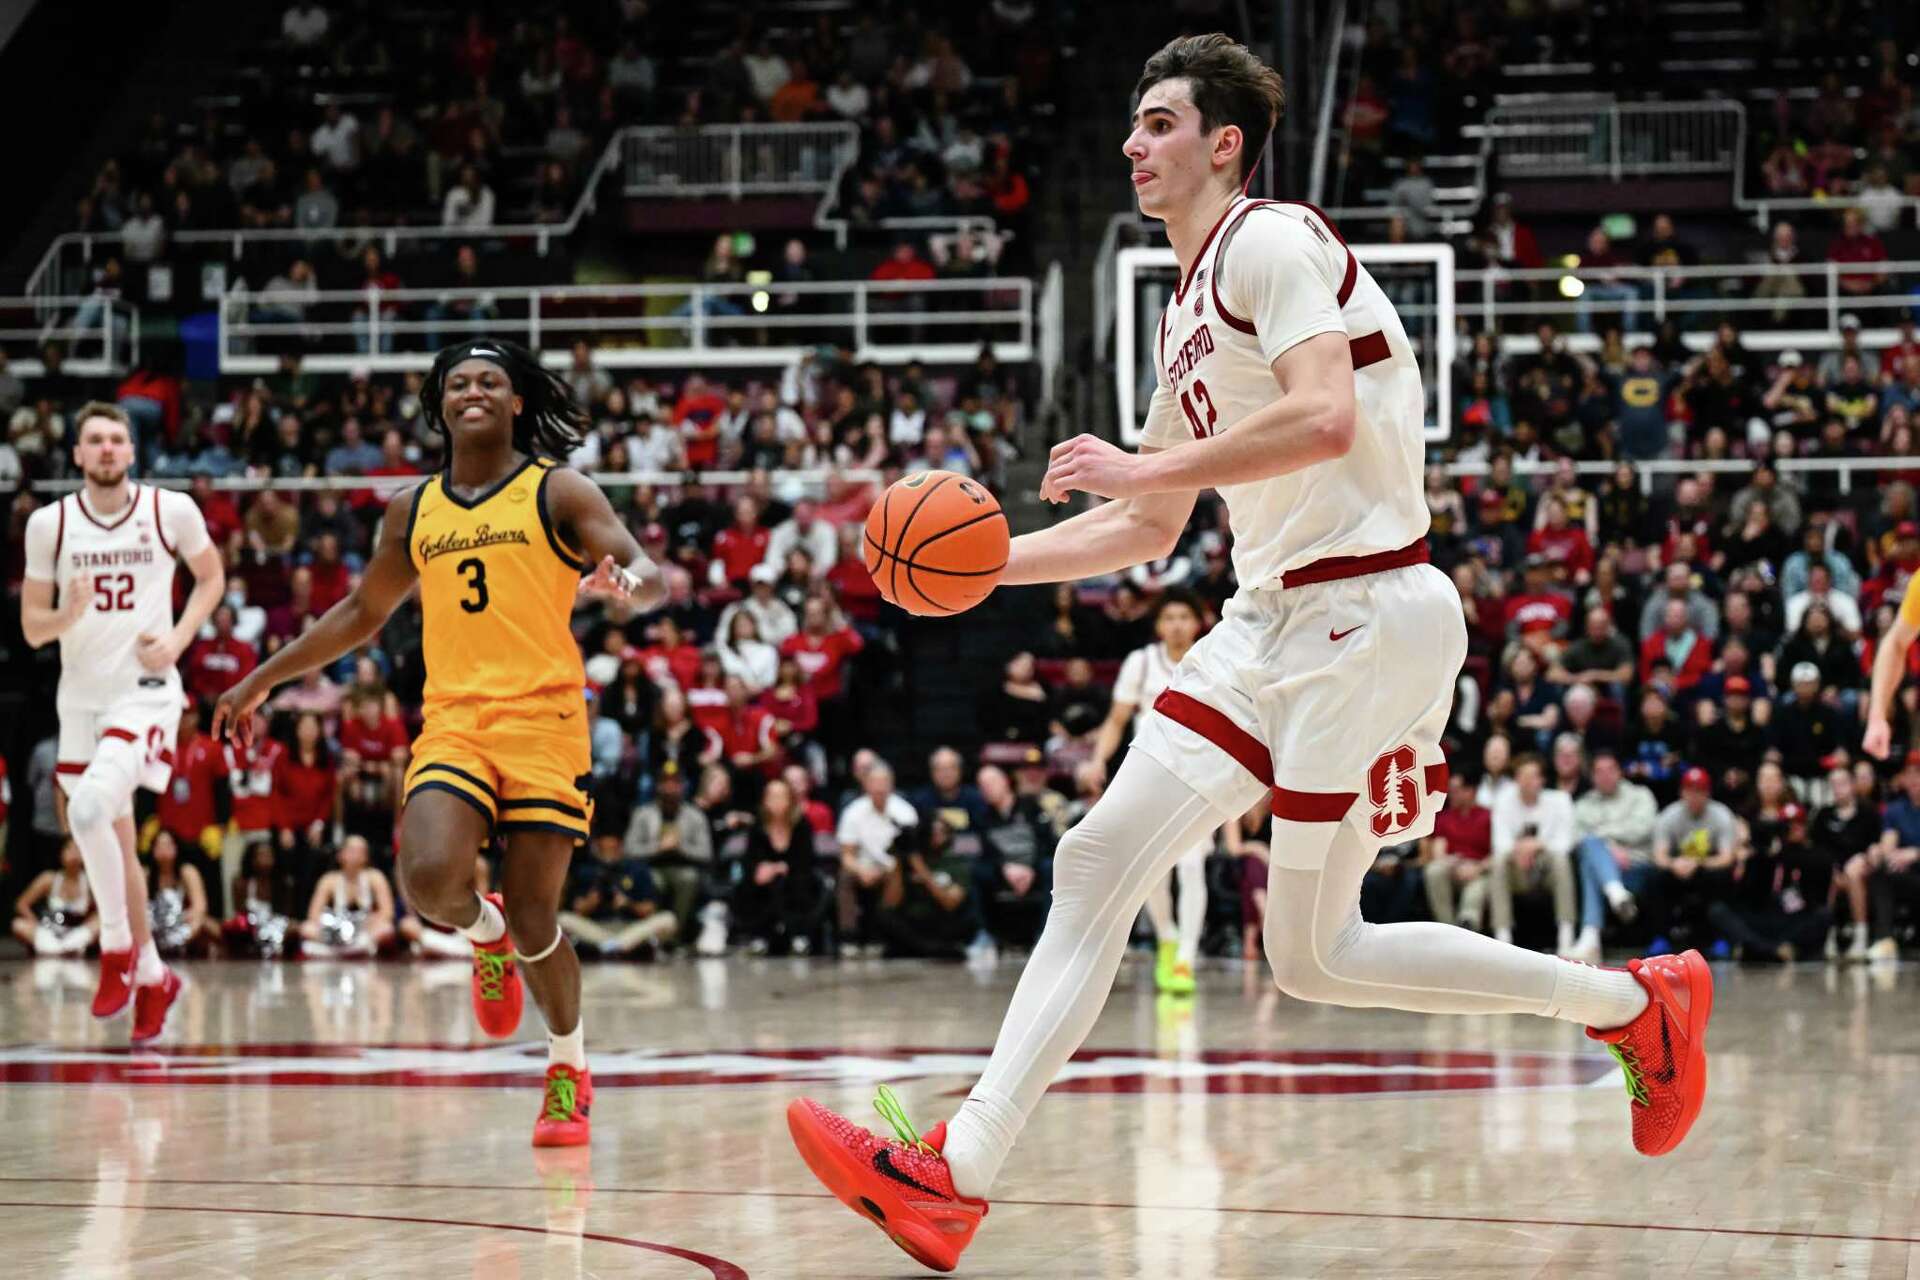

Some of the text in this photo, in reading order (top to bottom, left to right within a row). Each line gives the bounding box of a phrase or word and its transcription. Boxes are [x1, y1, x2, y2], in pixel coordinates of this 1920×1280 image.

[71, 549, 153, 568] STANFORD
[419, 523, 530, 566] Golden Bears
[93, 573, 135, 612] 52
[456, 557, 489, 614] 3
